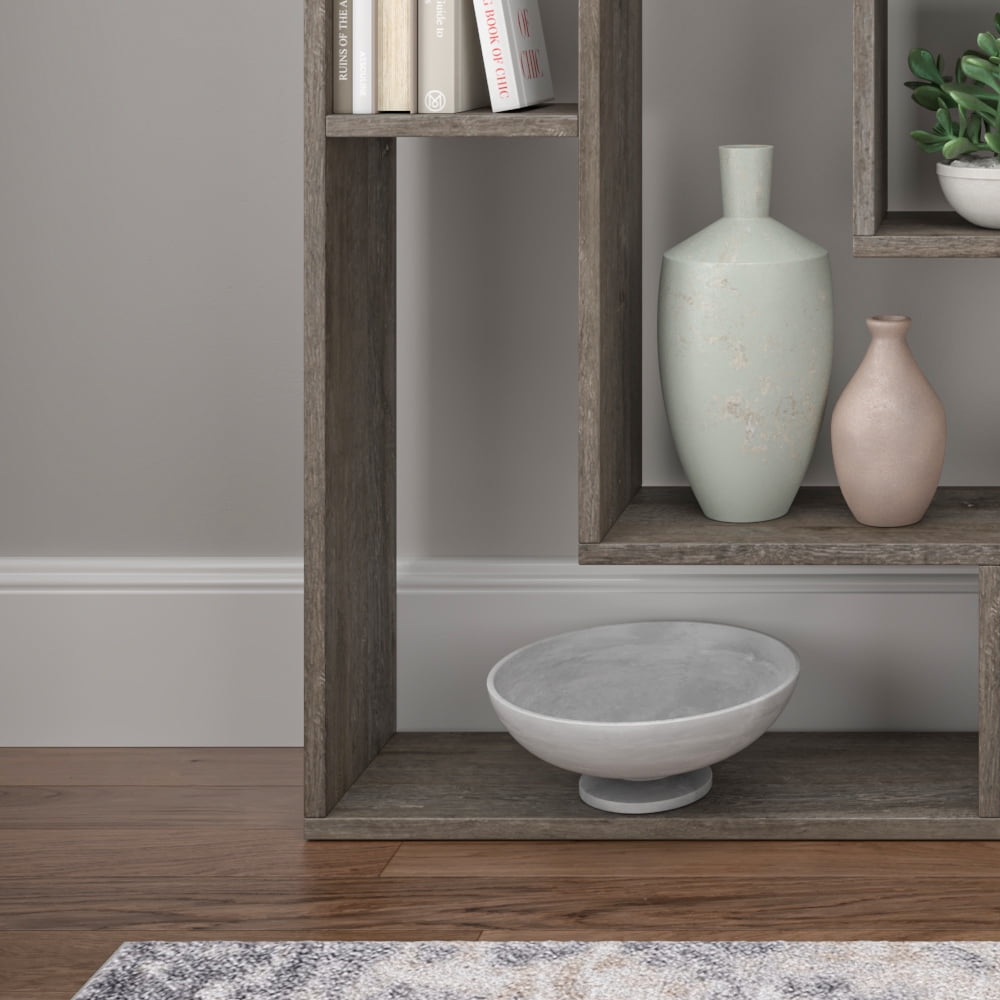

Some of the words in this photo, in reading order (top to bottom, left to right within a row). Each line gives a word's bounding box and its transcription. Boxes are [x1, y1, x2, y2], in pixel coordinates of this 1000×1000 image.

[339, 8, 348, 30] THE
[485, 9, 500, 45] BOOK
[339, 32, 348, 47] OF
[436, 27, 444, 38] to
[339, 48, 348, 81] RUINS
[492, 47, 504, 67] OF
[496, 67, 510, 99] CHIC
